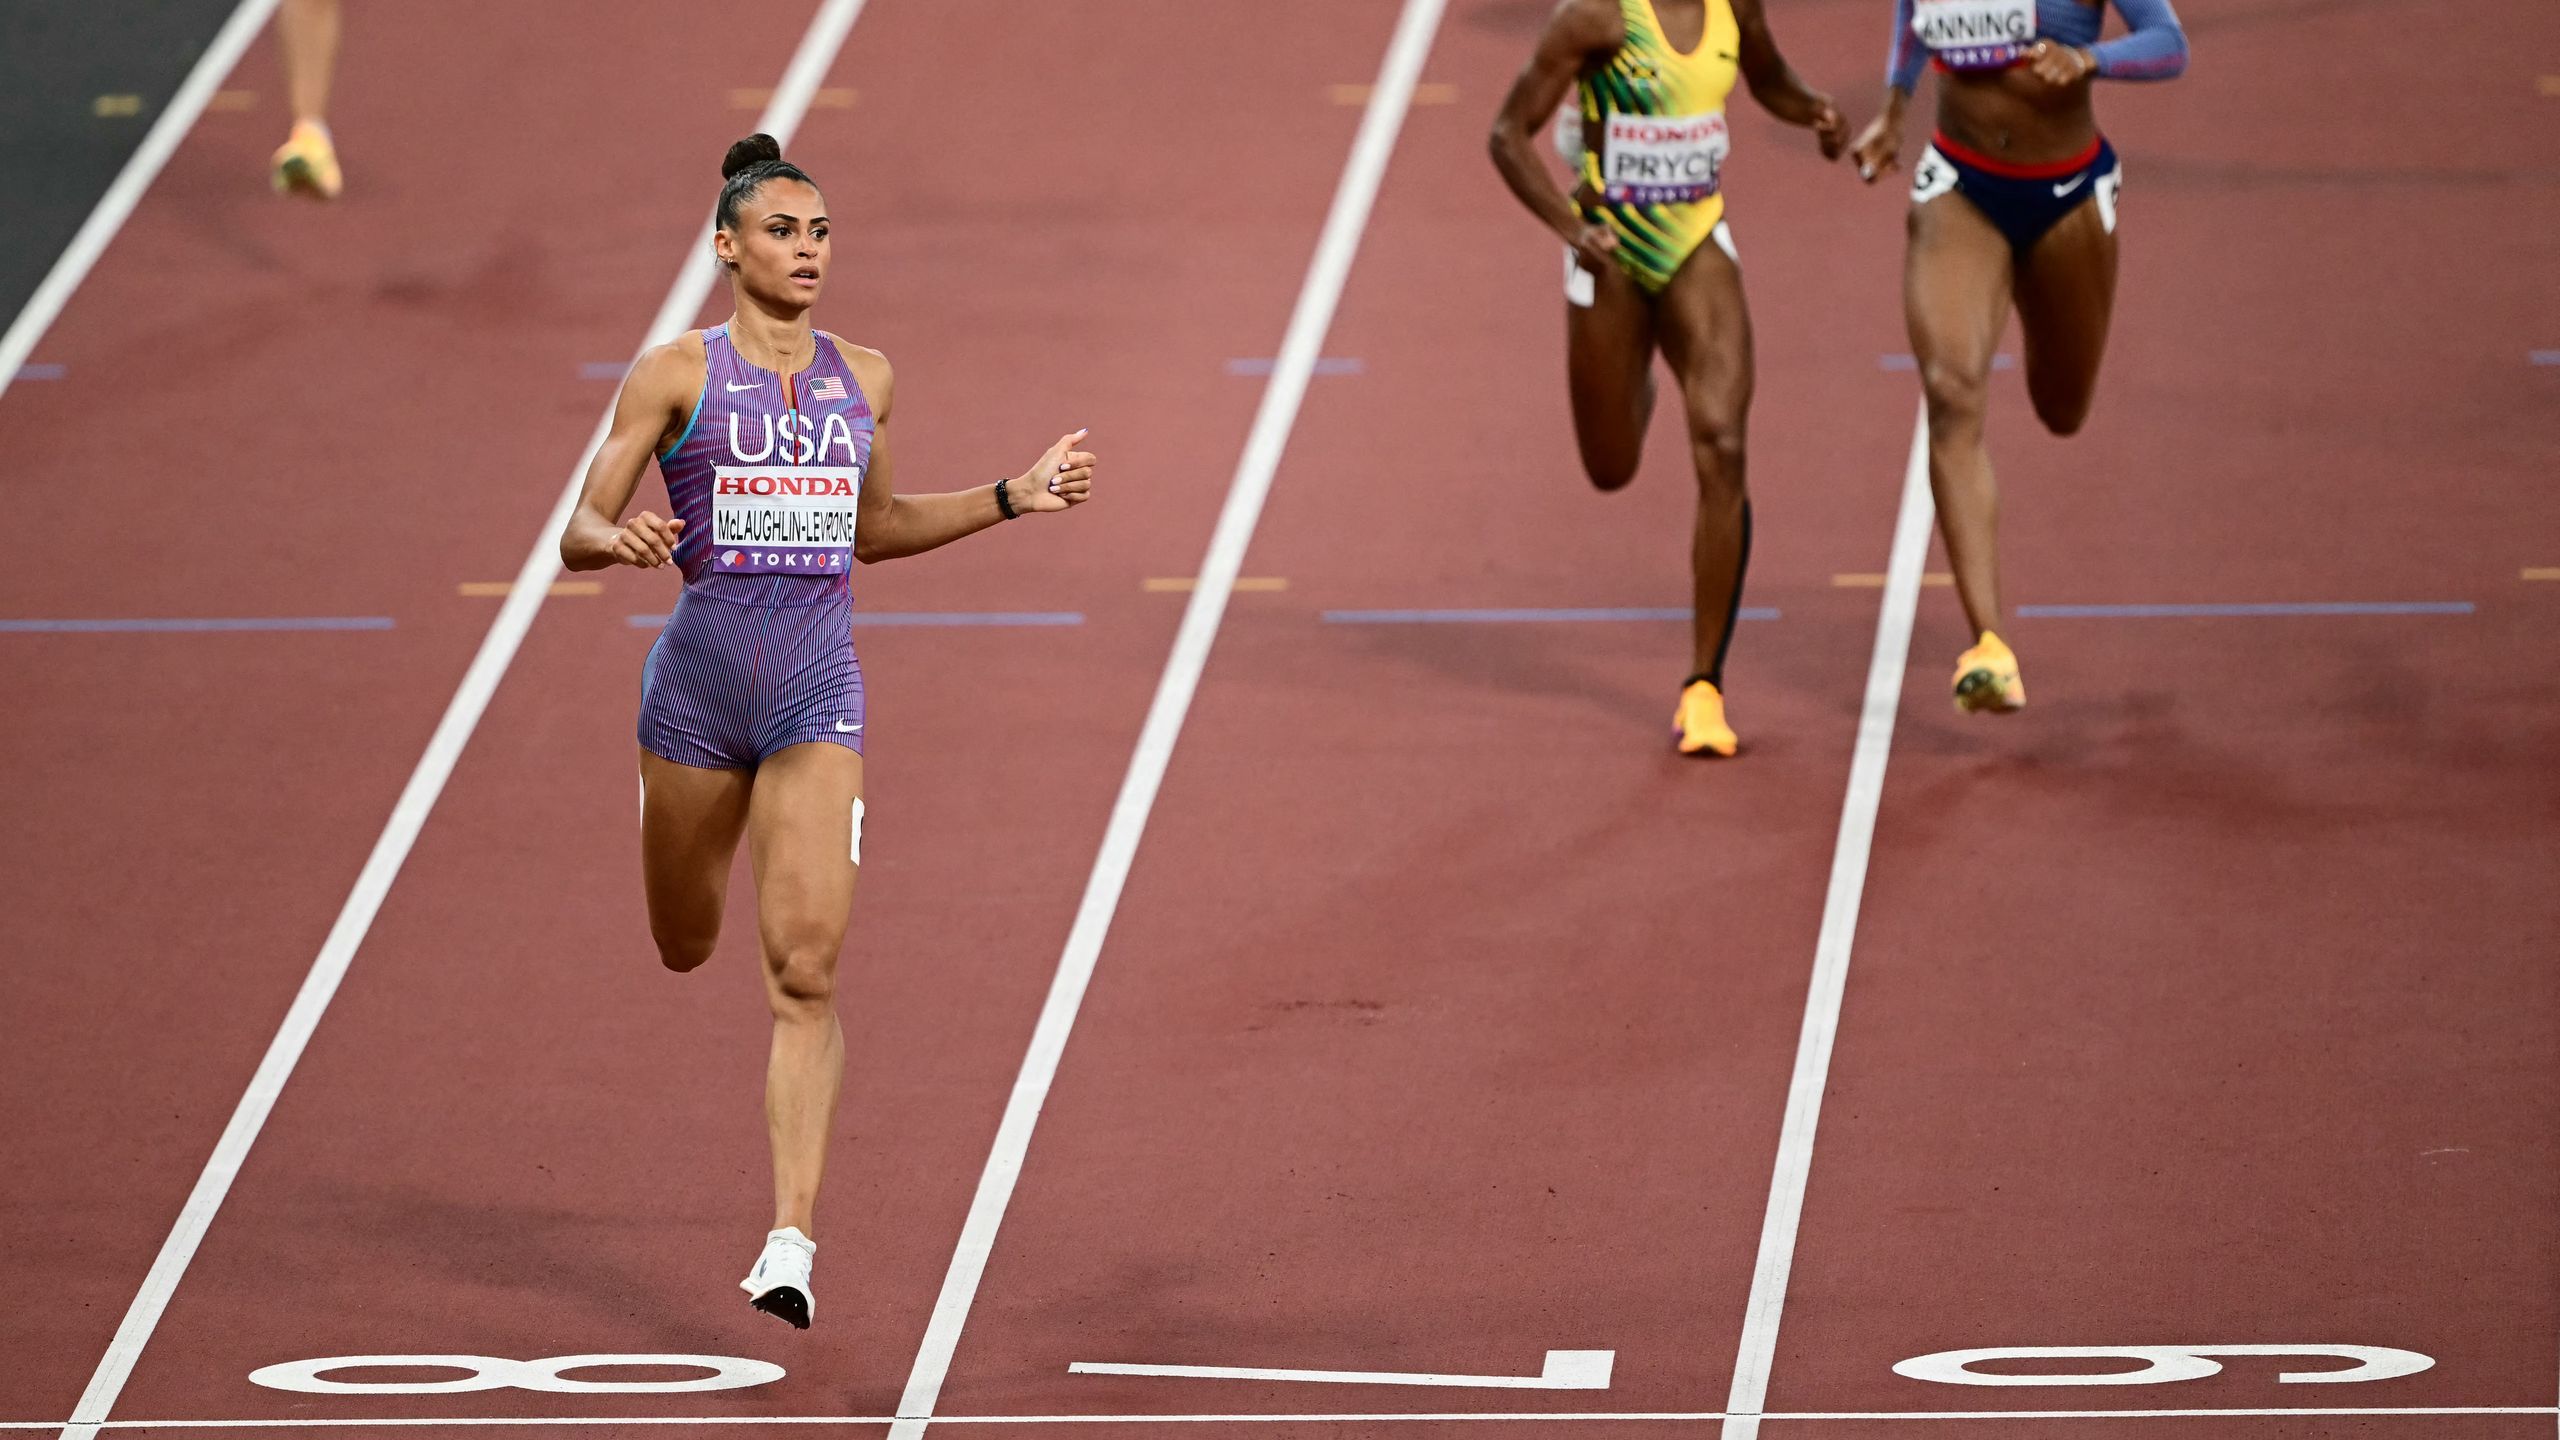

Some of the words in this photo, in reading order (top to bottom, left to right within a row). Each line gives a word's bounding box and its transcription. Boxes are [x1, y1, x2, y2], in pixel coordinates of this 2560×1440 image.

[1612, 119, 1725, 144] HONDA
[1616, 147, 1720, 178] PRYCE
[730, 412, 856, 463] USA
[716, 477, 854, 496] HONDA
[718, 510, 853, 542] McLAUGHLIN-LEVRONE
[248, 1353, 787, 1395] 8
[1067, 1349, 1616, 1390] 7
[1892, 1344, 2436, 1386] 6
